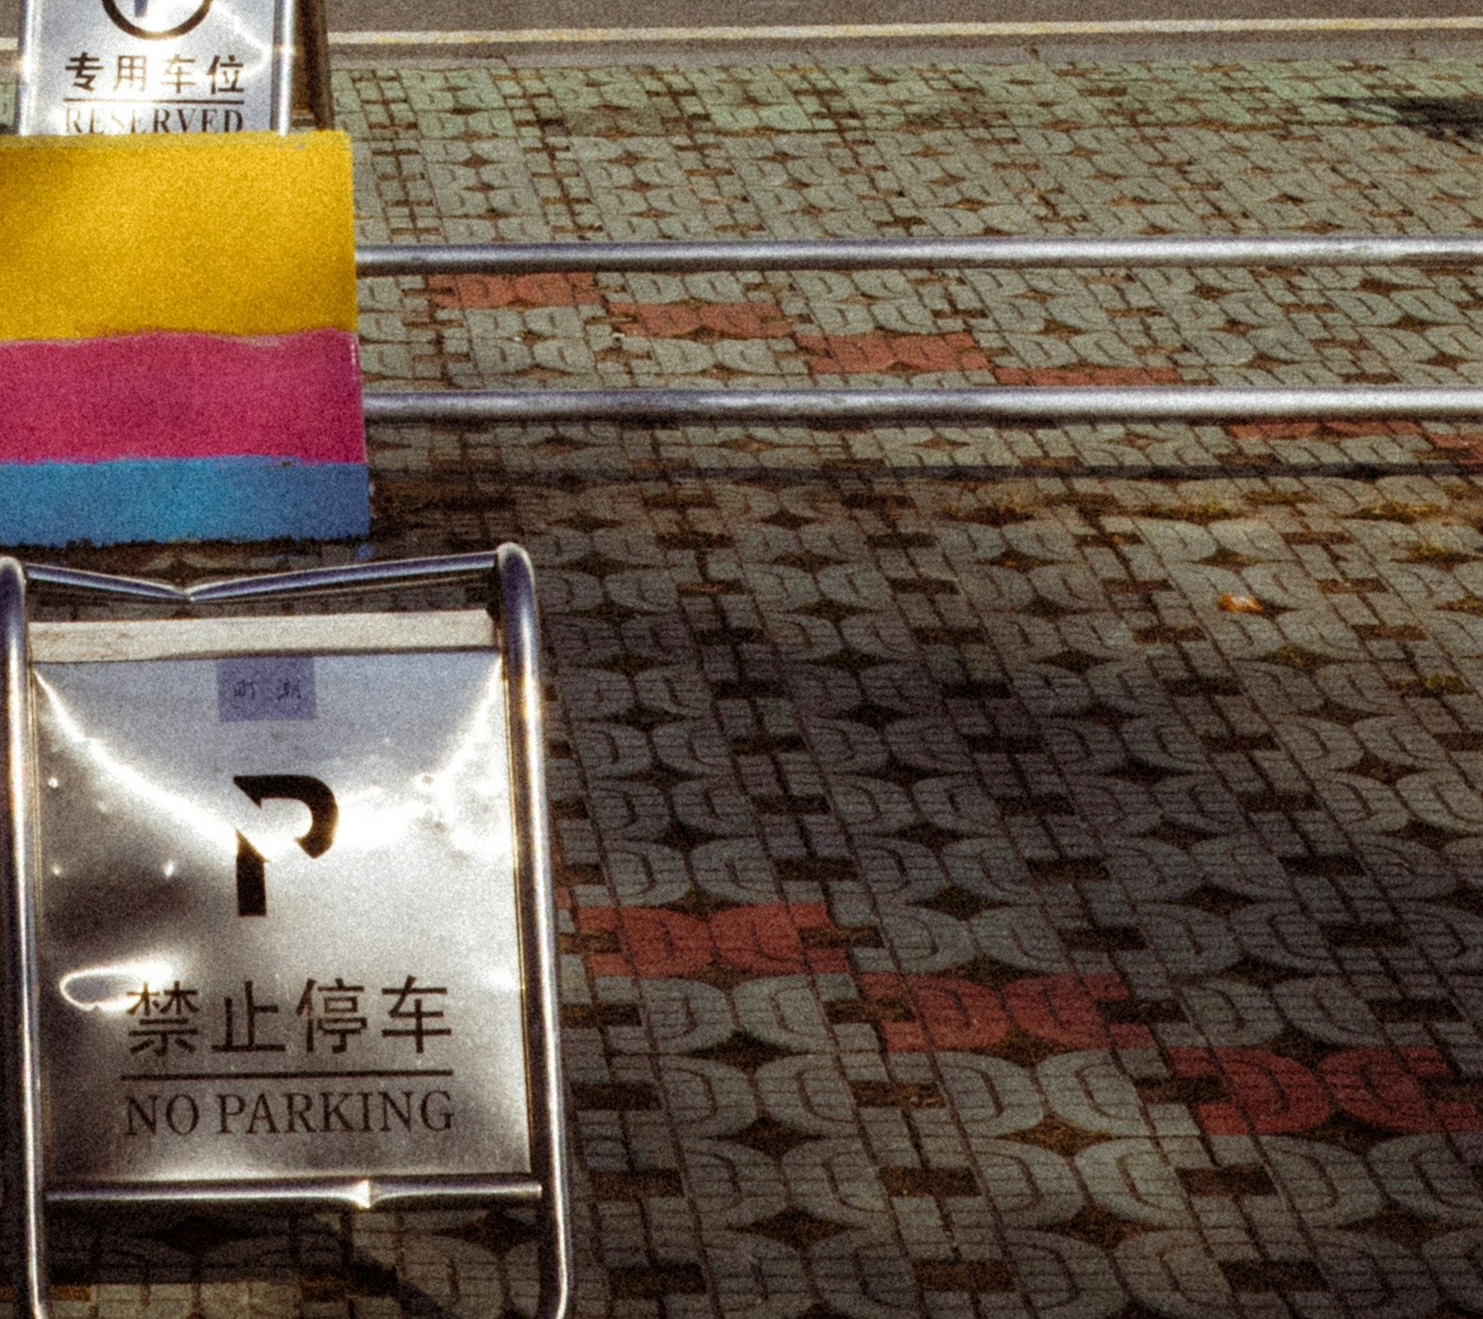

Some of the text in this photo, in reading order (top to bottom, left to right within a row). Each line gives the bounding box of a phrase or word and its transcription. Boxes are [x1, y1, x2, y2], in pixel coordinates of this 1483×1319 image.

[65, 52, 245, 94] 专用车位
[126, 975, 451, 1056] 禁止停车
[125, 1090, 455, 1136] NO PARKING
